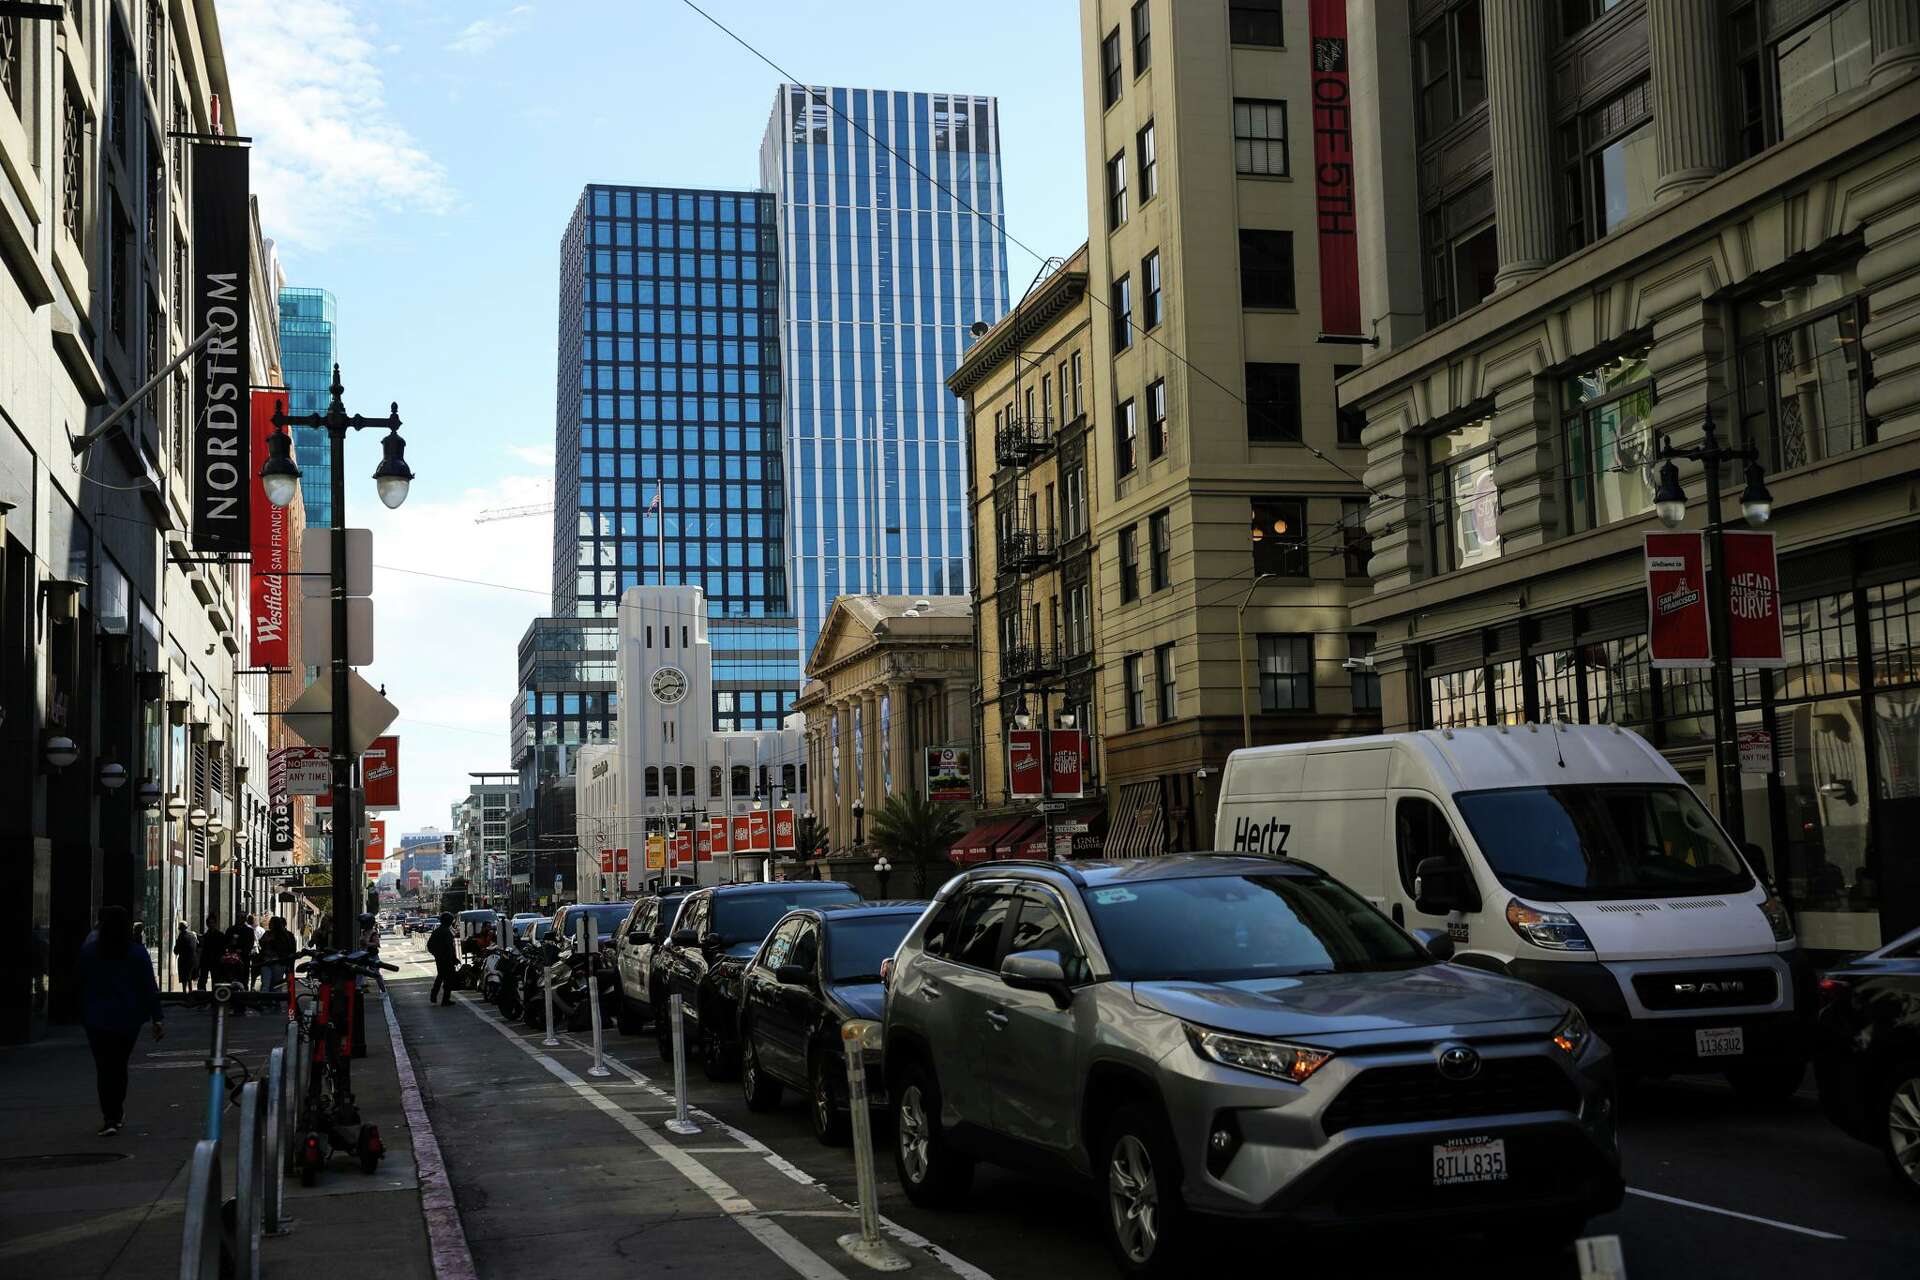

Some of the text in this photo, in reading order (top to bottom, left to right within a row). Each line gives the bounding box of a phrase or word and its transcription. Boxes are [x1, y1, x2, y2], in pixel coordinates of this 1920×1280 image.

[1314, 78, 1354, 235] OFF 5TH
[206, 272, 238, 520] NORDSTROM
[1730, 572, 1772, 596] AHEAD
[257, 574, 283, 645] Westfield
[271, 551, 282, 570] SAN
[1659, 594, 1673, 606] SAN
[1663, 592, 1697, 612] FRANCISCO
[1730, 596, 1772, 619] CURVE
[287, 760, 300, 768] NO
[1054, 761, 1077, 774] CURVE
[289, 772, 327, 781] ANY TIME
[275, 794, 289, 843] zetta
[1233, 816, 1291, 856] Hertz
[281, 866, 310, 875] zetta
[1674, 981, 1744, 993] RAM
[1436, 1152, 1503, 1179] 8TLL835
